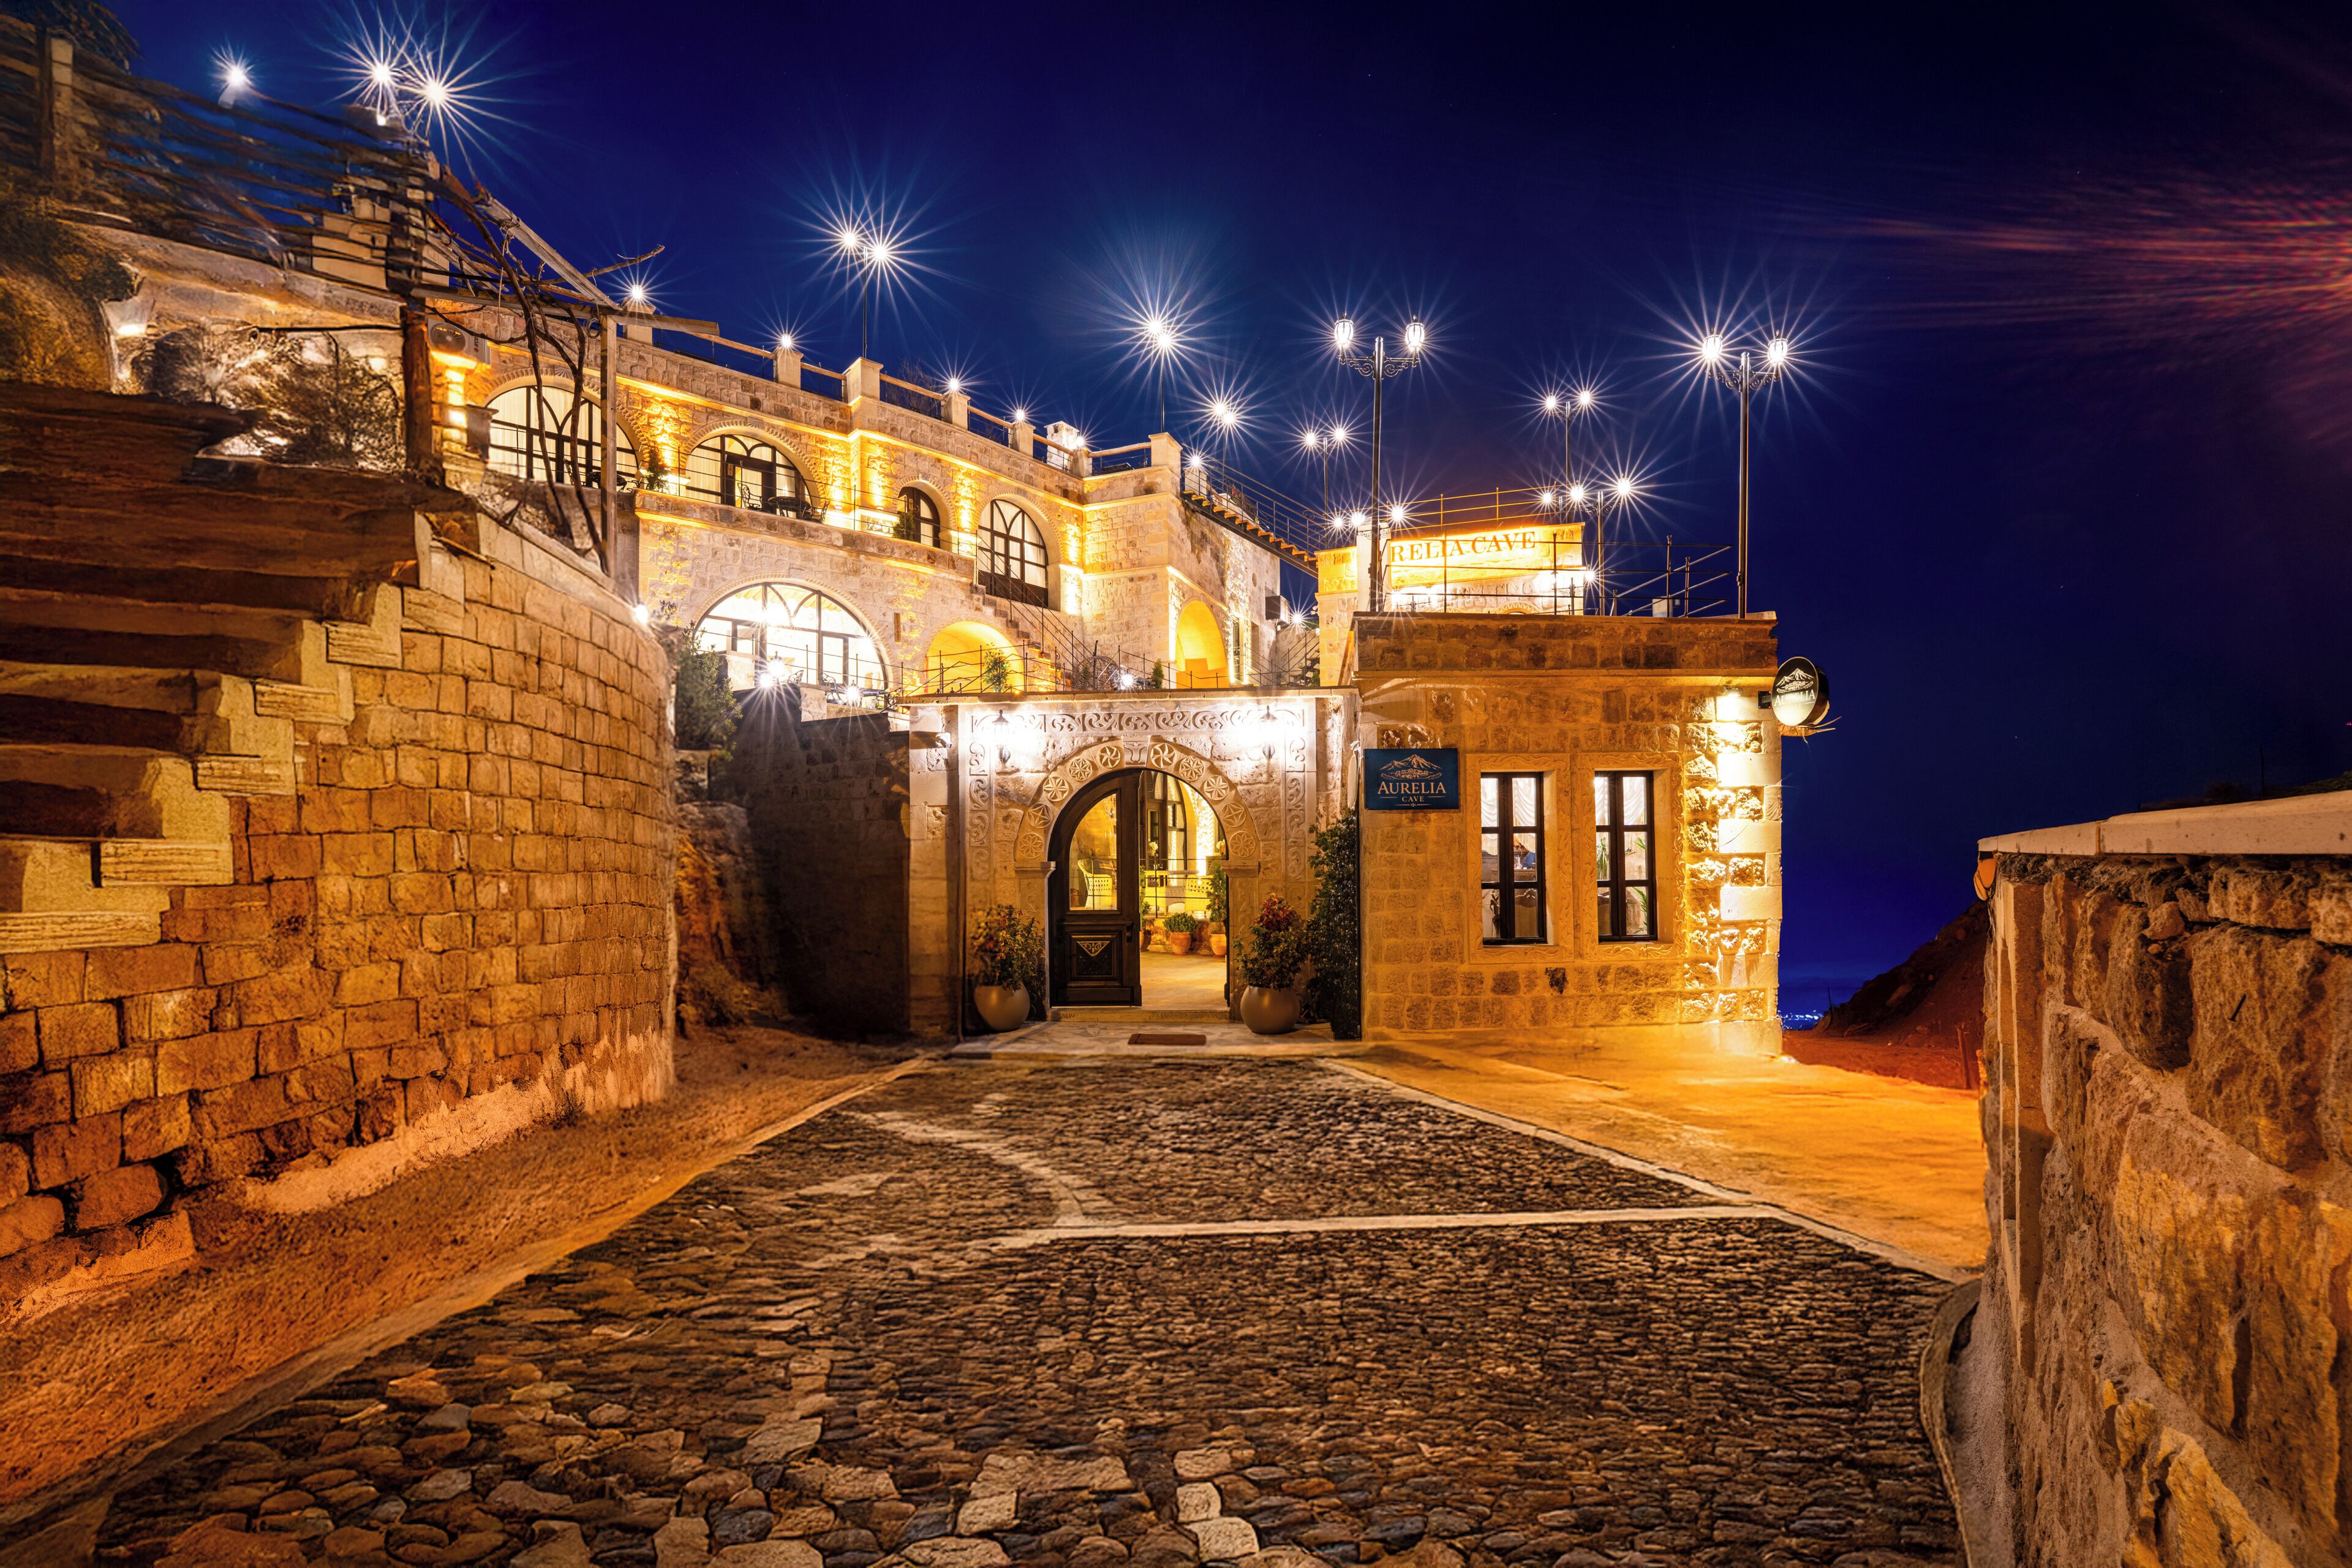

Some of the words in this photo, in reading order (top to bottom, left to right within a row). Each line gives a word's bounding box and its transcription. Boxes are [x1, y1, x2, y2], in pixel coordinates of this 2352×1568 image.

[1391, 539, 1465, 562] RELIA
[1471, 531, 1535, 554] CAVE
[1378, 781, 1446, 794] AURELIA
